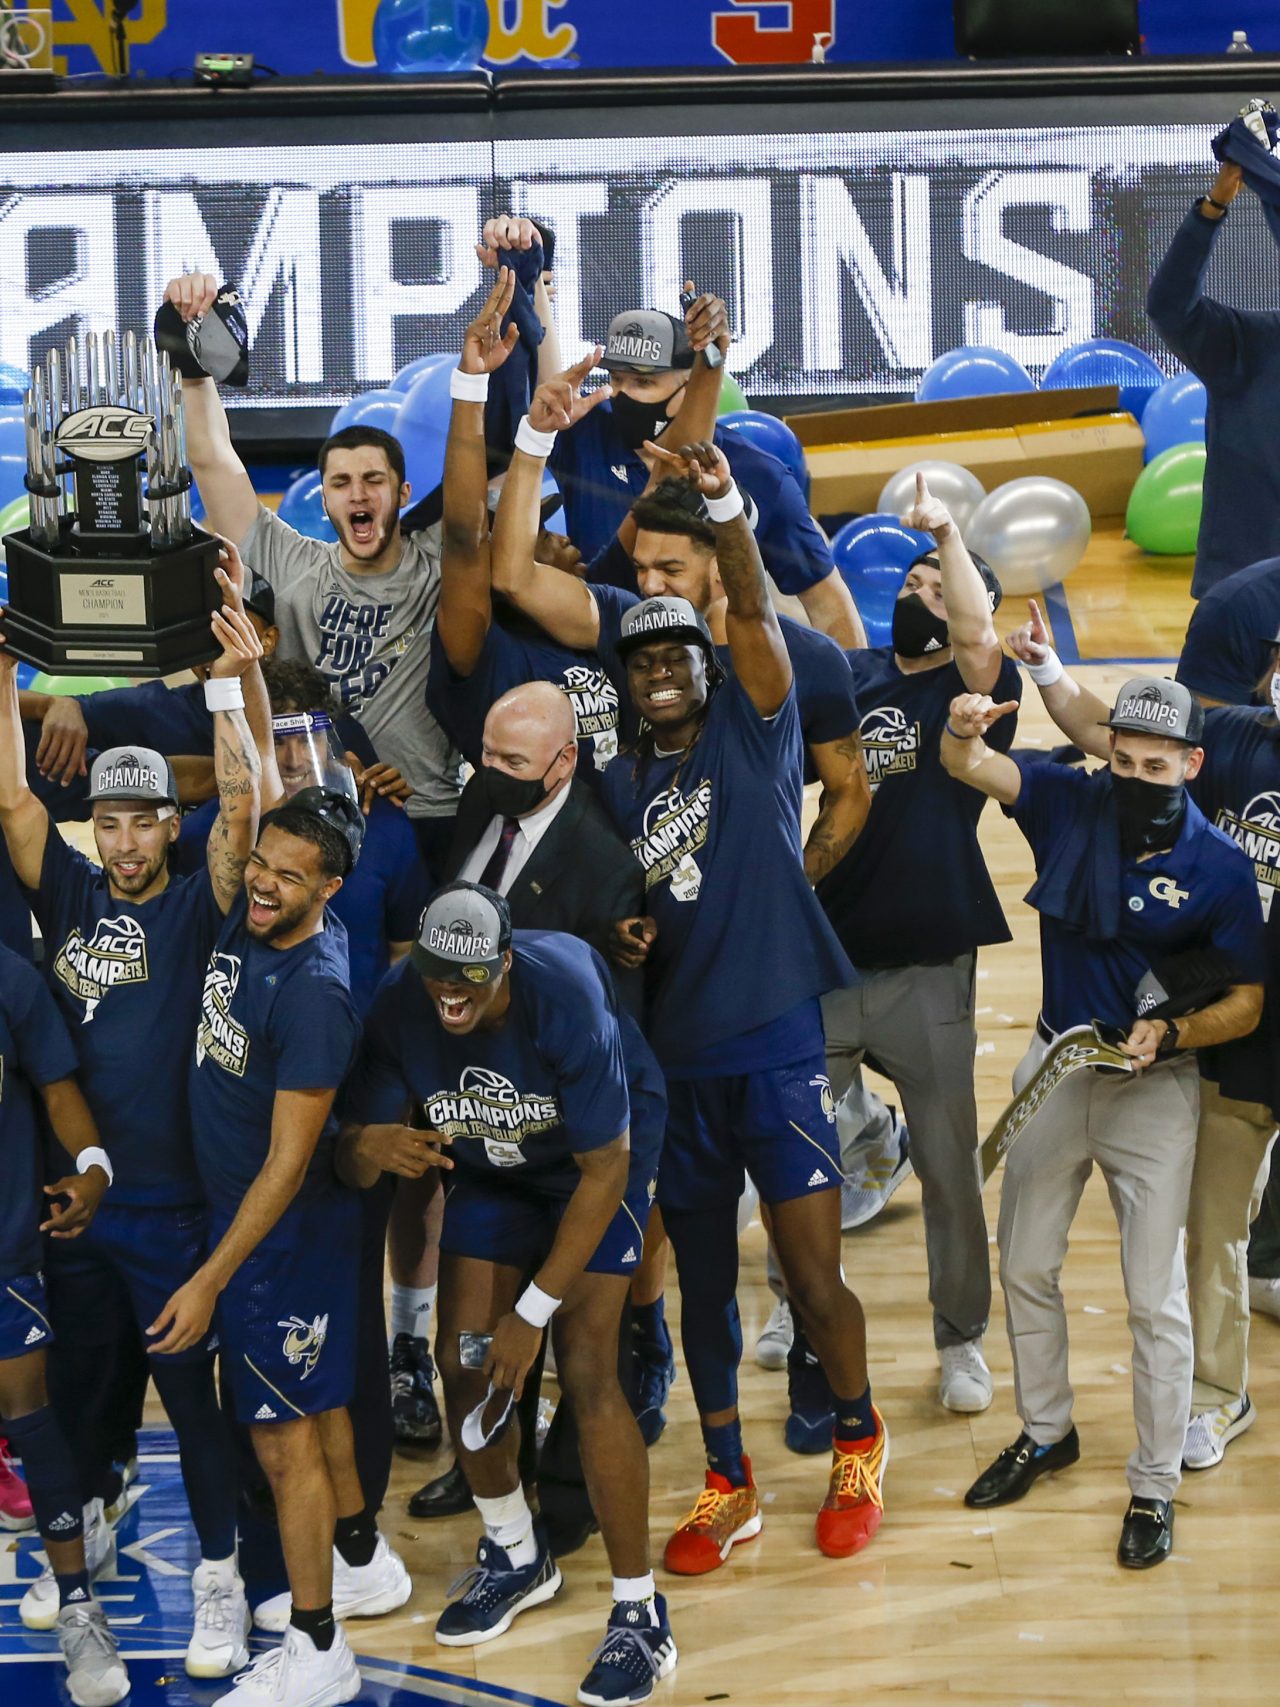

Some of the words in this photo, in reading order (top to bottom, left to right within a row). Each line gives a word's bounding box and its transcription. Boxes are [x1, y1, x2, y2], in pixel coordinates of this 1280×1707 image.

[608, 335, 662, 361] CHAMPS
[55, 415, 156, 443] ACC
[89, 579, 115, 588] ACC
[82, 599, 125, 610] CHAMPION
[320, 596, 395, 638] HERE
[628, 611, 688, 635] CHAMPS
[1119, 698, 1180, 728] CHAMPS
[98, 767, 159, 791] CHAMPS
[1148, 876, 1190, 909] GT
[429, 927, 492, 957] CHAMPS
[467, 1083, 516, 1103] ACC
[428, 1098, 558, 1129] CHAMPIONS
